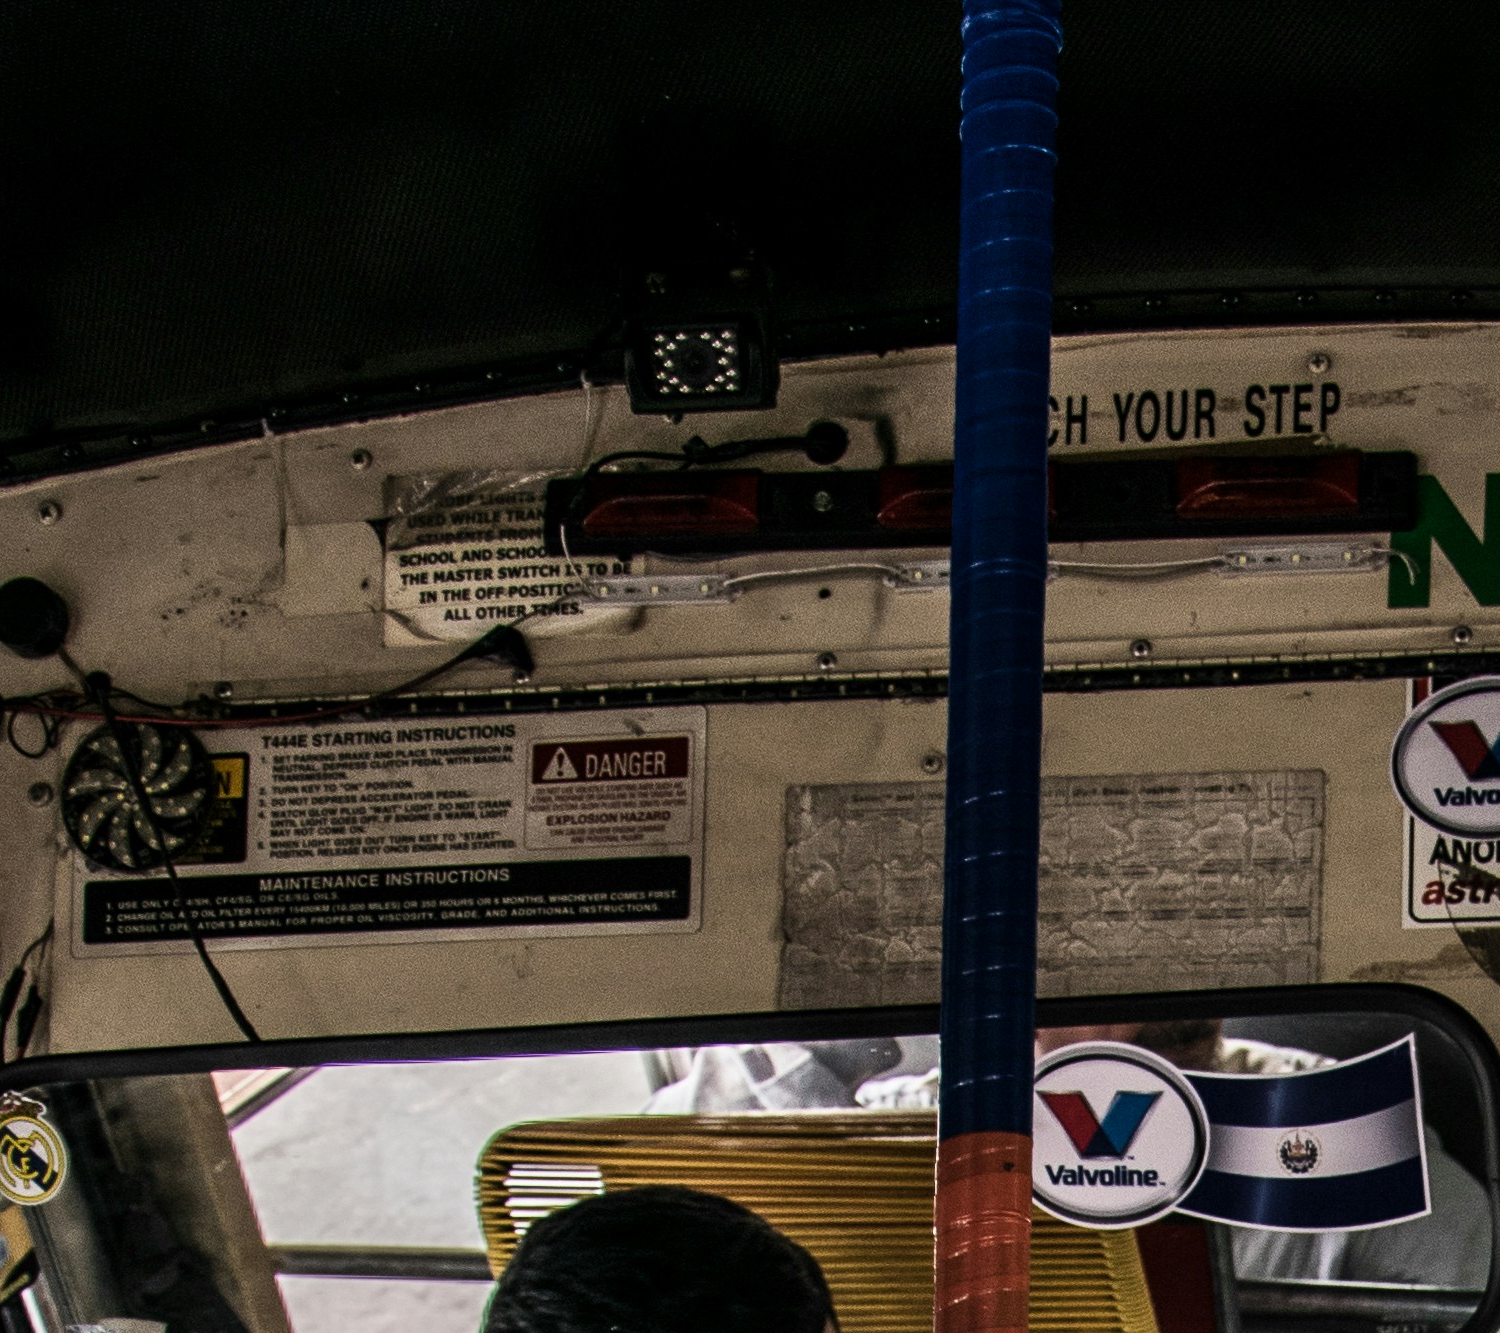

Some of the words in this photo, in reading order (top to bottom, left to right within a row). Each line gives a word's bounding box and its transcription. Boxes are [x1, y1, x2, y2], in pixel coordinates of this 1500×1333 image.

[1113, 388, 1217, 441] YOUR
[1243, 382, 1342, 437] STEP
[450, 510, 500, 524] WHILE
[400, 551, 456, 567] SCHOOL
[462, 548, 492, 561] AND
[497, 546, 547, 560] SCHOO
[400, 572, 428, 585] THE
[434, 568, 492, 583] MASTER
[498, 565, 559, 580] SWITCH
[565, 564, 582, 577] IS
[587, 563, 607, 576] TO
[613, 562, 631, 575] BE
[420, 590, 438, 603] IN
[443, 588, 471, 602] THE
[475, 586, 504, 600] OFF
[444, 607, 472, 621] ALL
[476, 604, 526, 618] OTHER
[262, 735, 307, 748] T444E
[313, 731, 392, 746] STARTING
[397, 726, 515, 743] INSTRUCTIONS
[585, 750, 667, 778] DANGER
[546, 811, 617, 826] EXPLOSION
[620, 810, 671, 823] HAZARD
[259, 873, 380, 892] MAINTENANCE
[385, 867, 511, 887] INSTRUCTIONS
[548, 892, 608, 903] WHICHEVER
[610, 890, 645, 901] COMES
[117, 924, 165, 933] CONSULT
[238, 918, 282, 929] MANUAL
[286, 917, 307, 926] FOR
[311, 915, 353, 925] PROPER
[485, 908, 507, 918] AND
[511, 906, 576, 917] ADDITIONAL
[1045, 1165, 1158, 1187] Valvoline
